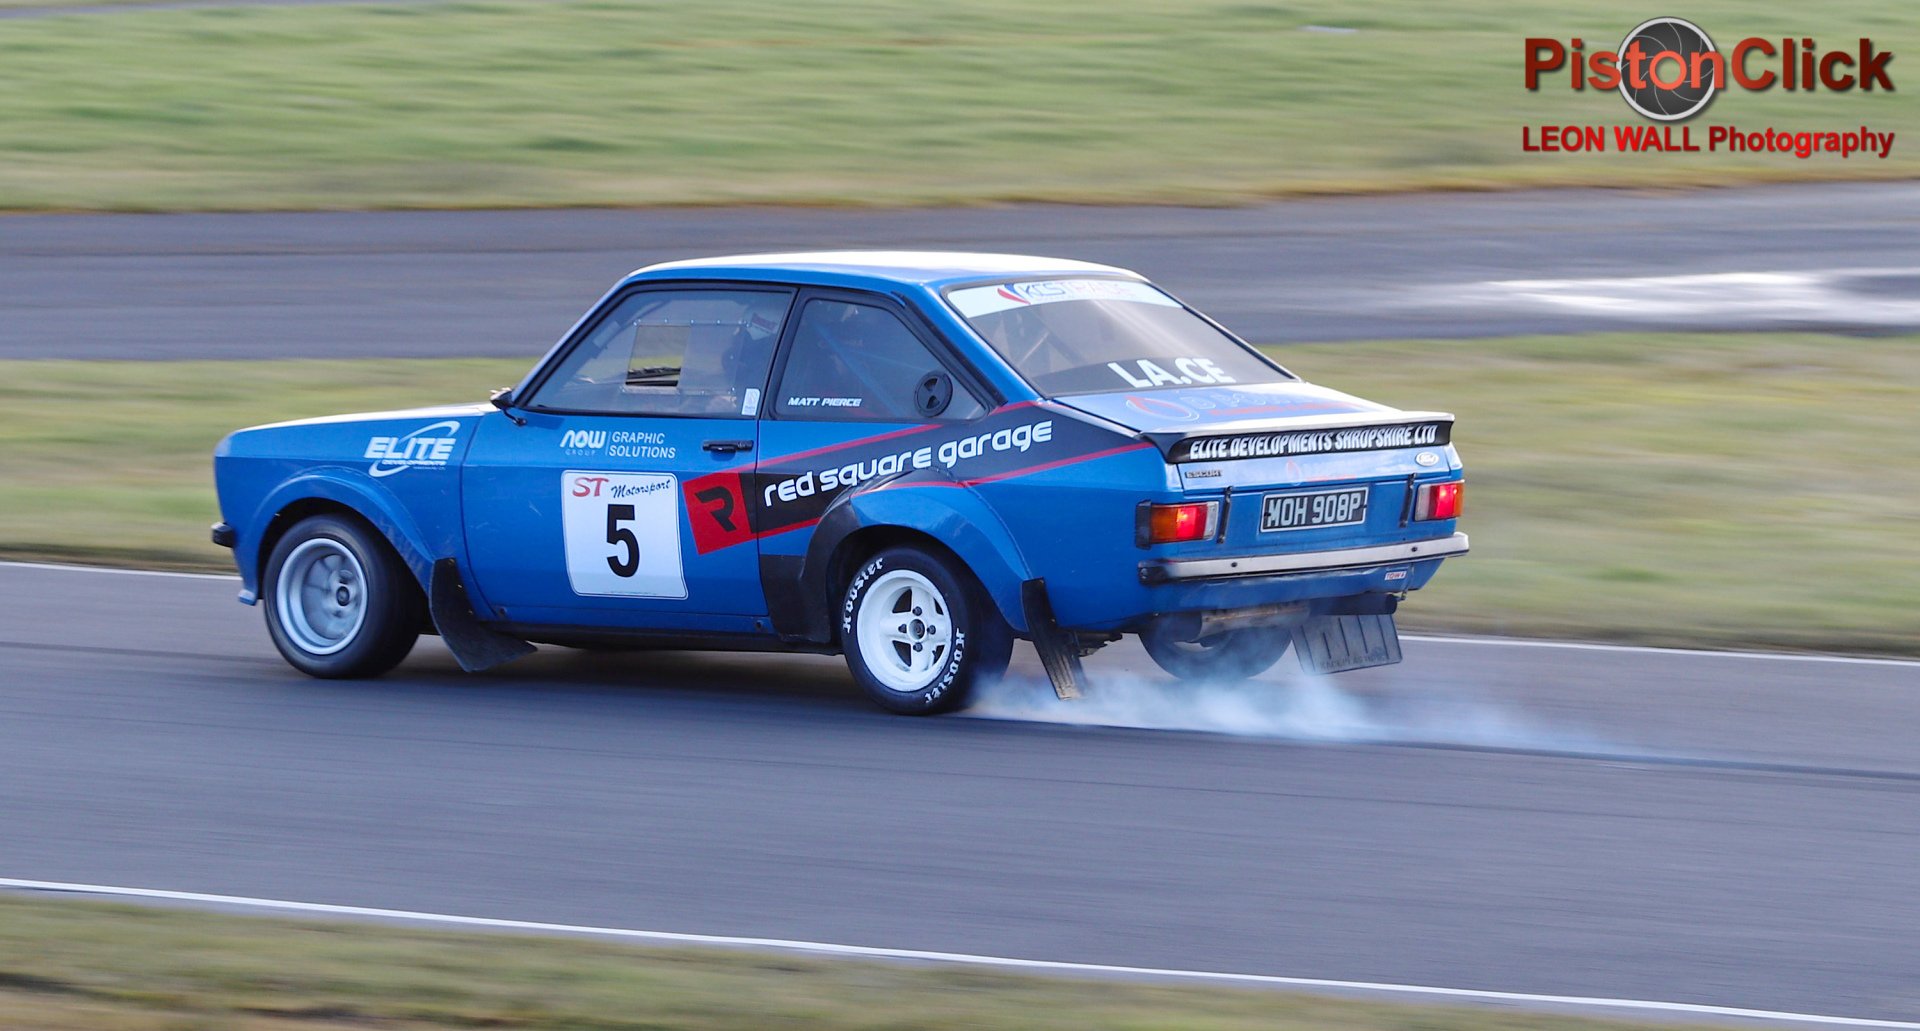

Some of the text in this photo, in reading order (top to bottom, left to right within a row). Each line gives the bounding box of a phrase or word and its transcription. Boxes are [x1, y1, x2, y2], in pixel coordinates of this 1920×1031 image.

[787, 397, 862, 407] MATT PIERCE
[363, 436, 456, 460] ELITE
[611, 431, 666, 445] GRAPHIC
[1190, 423, 1438, 460] ELITE DEVELOPMENTS SHROPSHIRE LTD
[608, 445, 676, 459] SOLUTIONS
[763, 420, 1053, 507] red square garage
[572, 477, 671, 499] ST Motorsport
[1267, 492, 1362, 528] MOH 908P
[606, 503, 640, 578] 5
